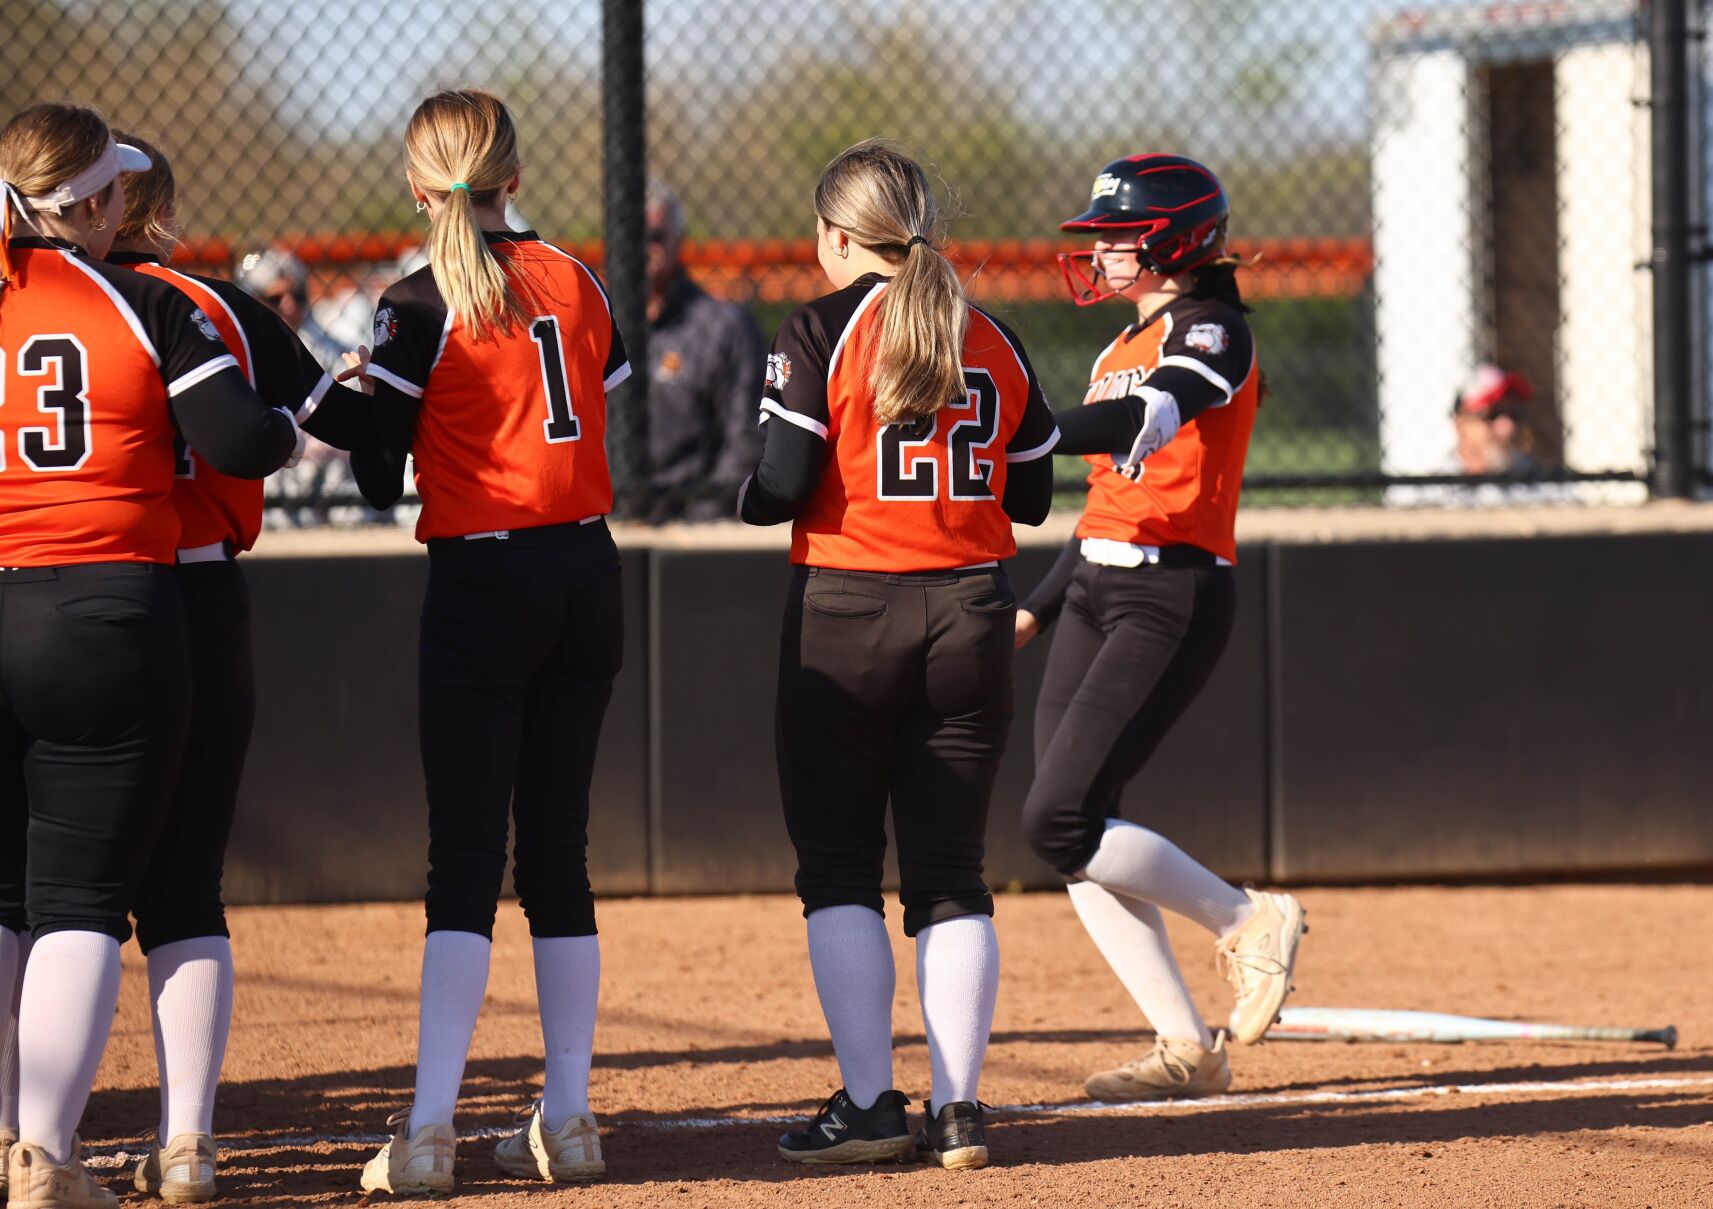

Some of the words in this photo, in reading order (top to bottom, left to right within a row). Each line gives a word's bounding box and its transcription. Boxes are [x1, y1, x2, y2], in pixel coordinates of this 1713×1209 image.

[0, 333, 93, 472] 3
[529, 315, 581, 444] 1
[877, 367, 1000, 501] 22
[820, 1112, 848, 1141] N
